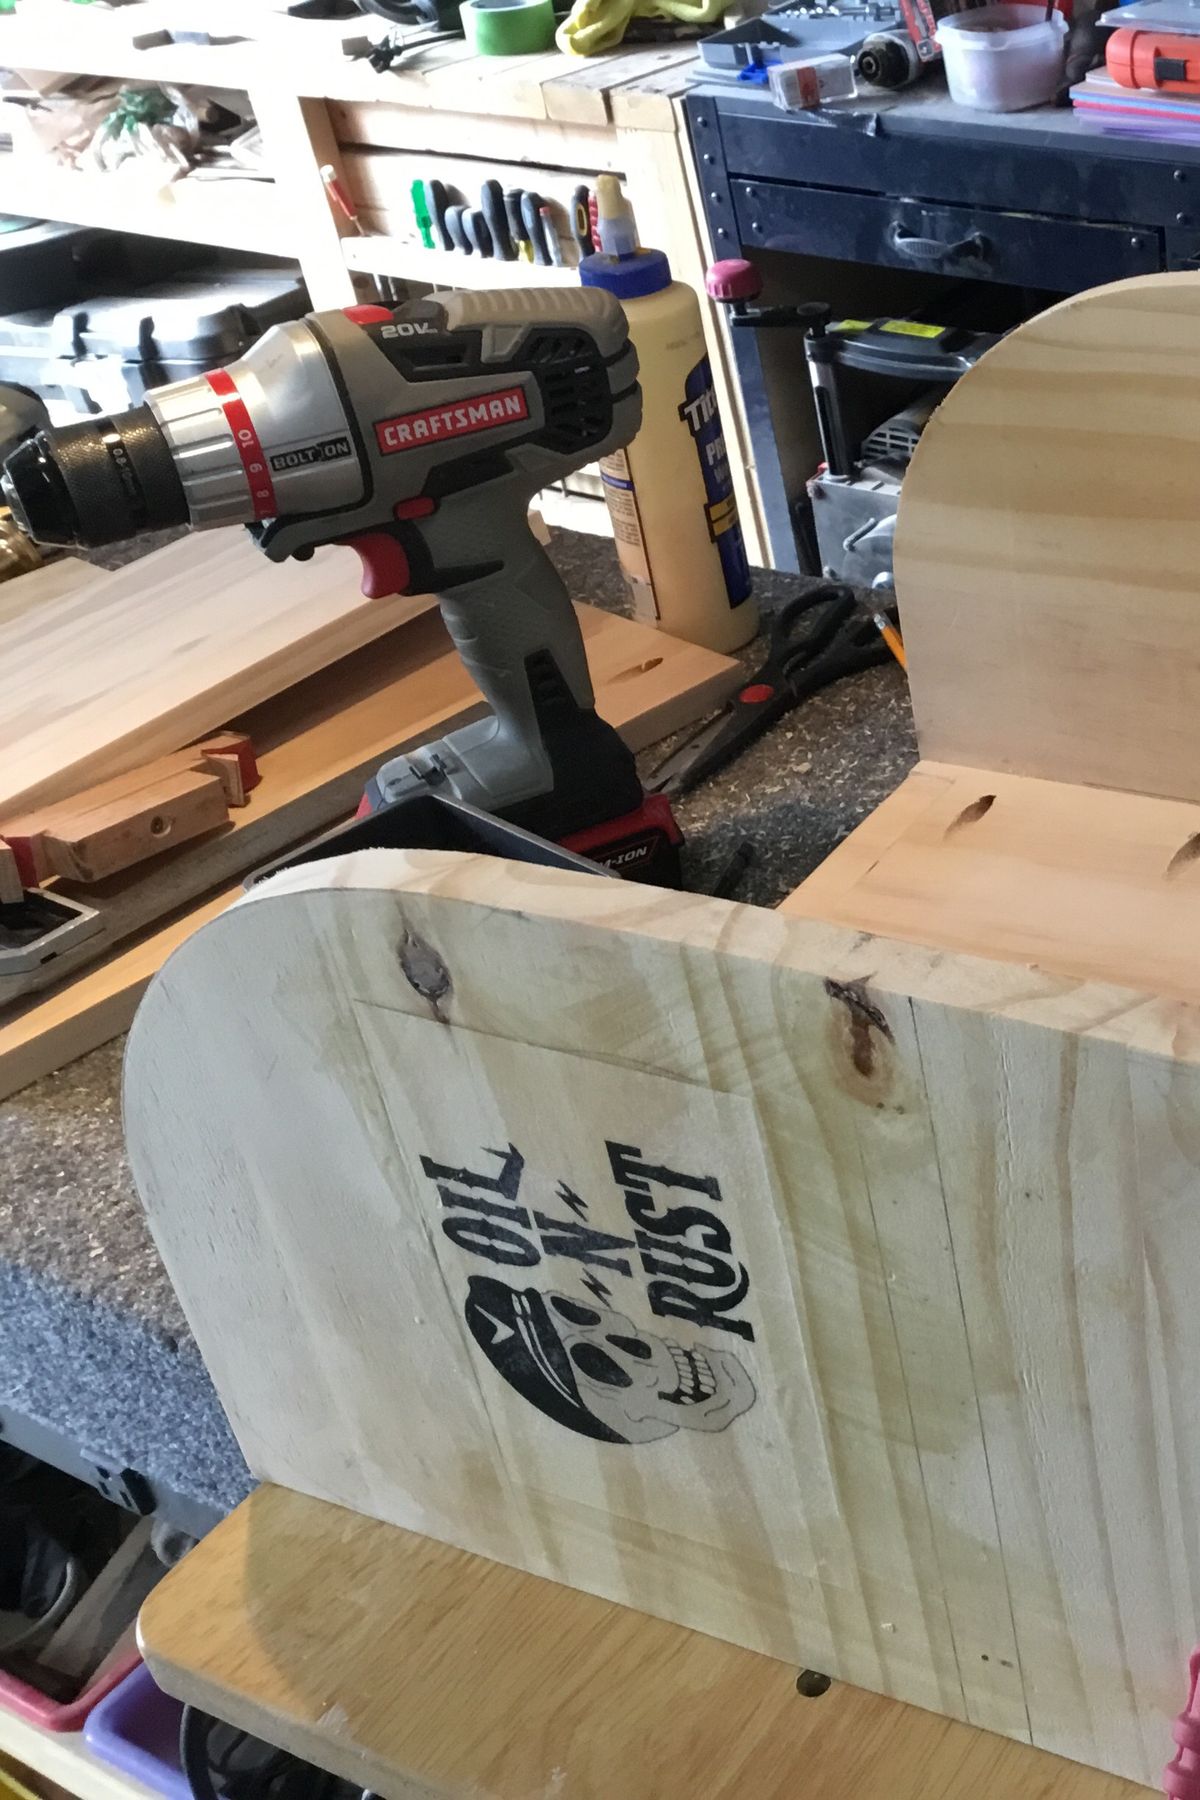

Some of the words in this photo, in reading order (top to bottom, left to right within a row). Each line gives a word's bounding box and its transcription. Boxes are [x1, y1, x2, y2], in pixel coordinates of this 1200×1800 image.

[238, 429, 255, 449] 10
[384, 395, 521, 446] CRAFTSMAN
[419, 1142, 542, 1267] OIL
[604, 1140, 755, 1343] RUST
